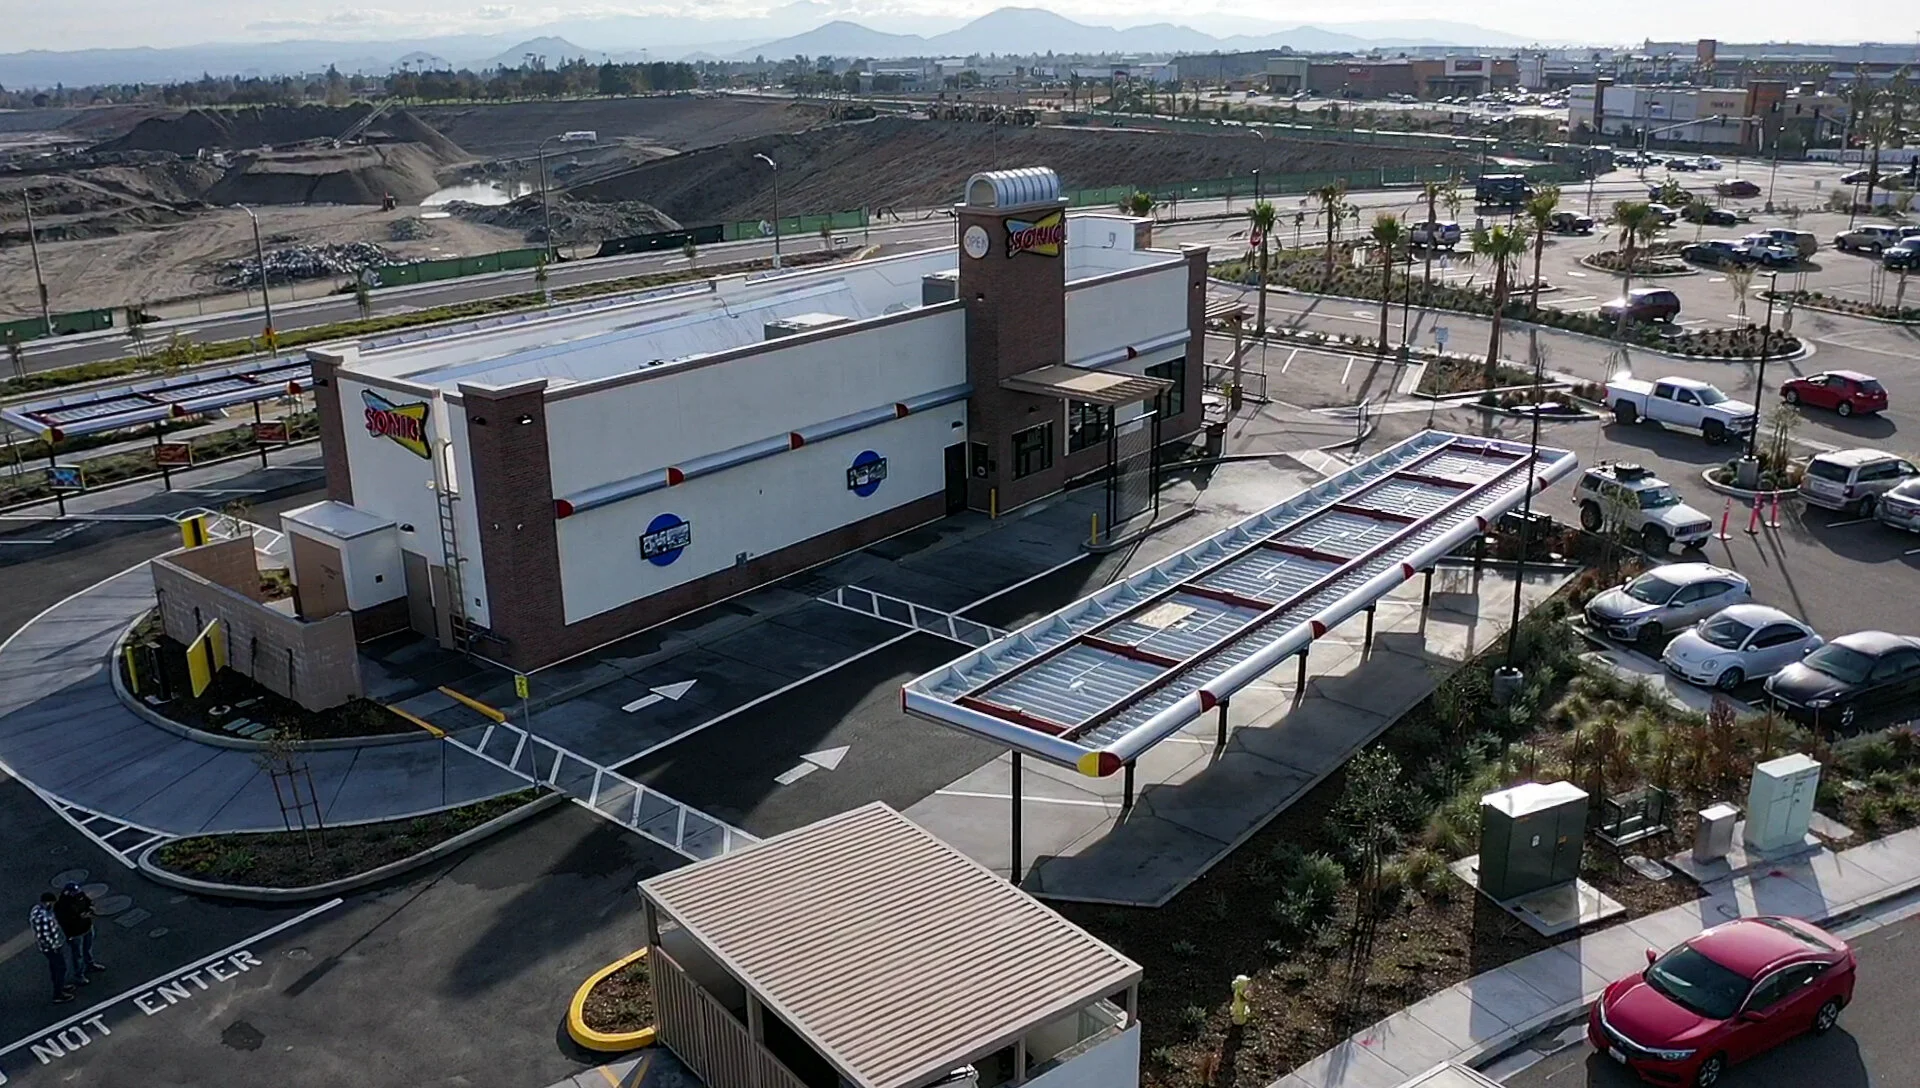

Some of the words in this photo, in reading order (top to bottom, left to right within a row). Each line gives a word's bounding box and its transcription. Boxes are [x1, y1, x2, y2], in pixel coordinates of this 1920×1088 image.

[1009, 224, 1063, 250] SONIC
[364, 407, 421, 442] SONIC
[30, 1013, 112, 1065] NOT
[133, 950, 263, 1016] ENTER
